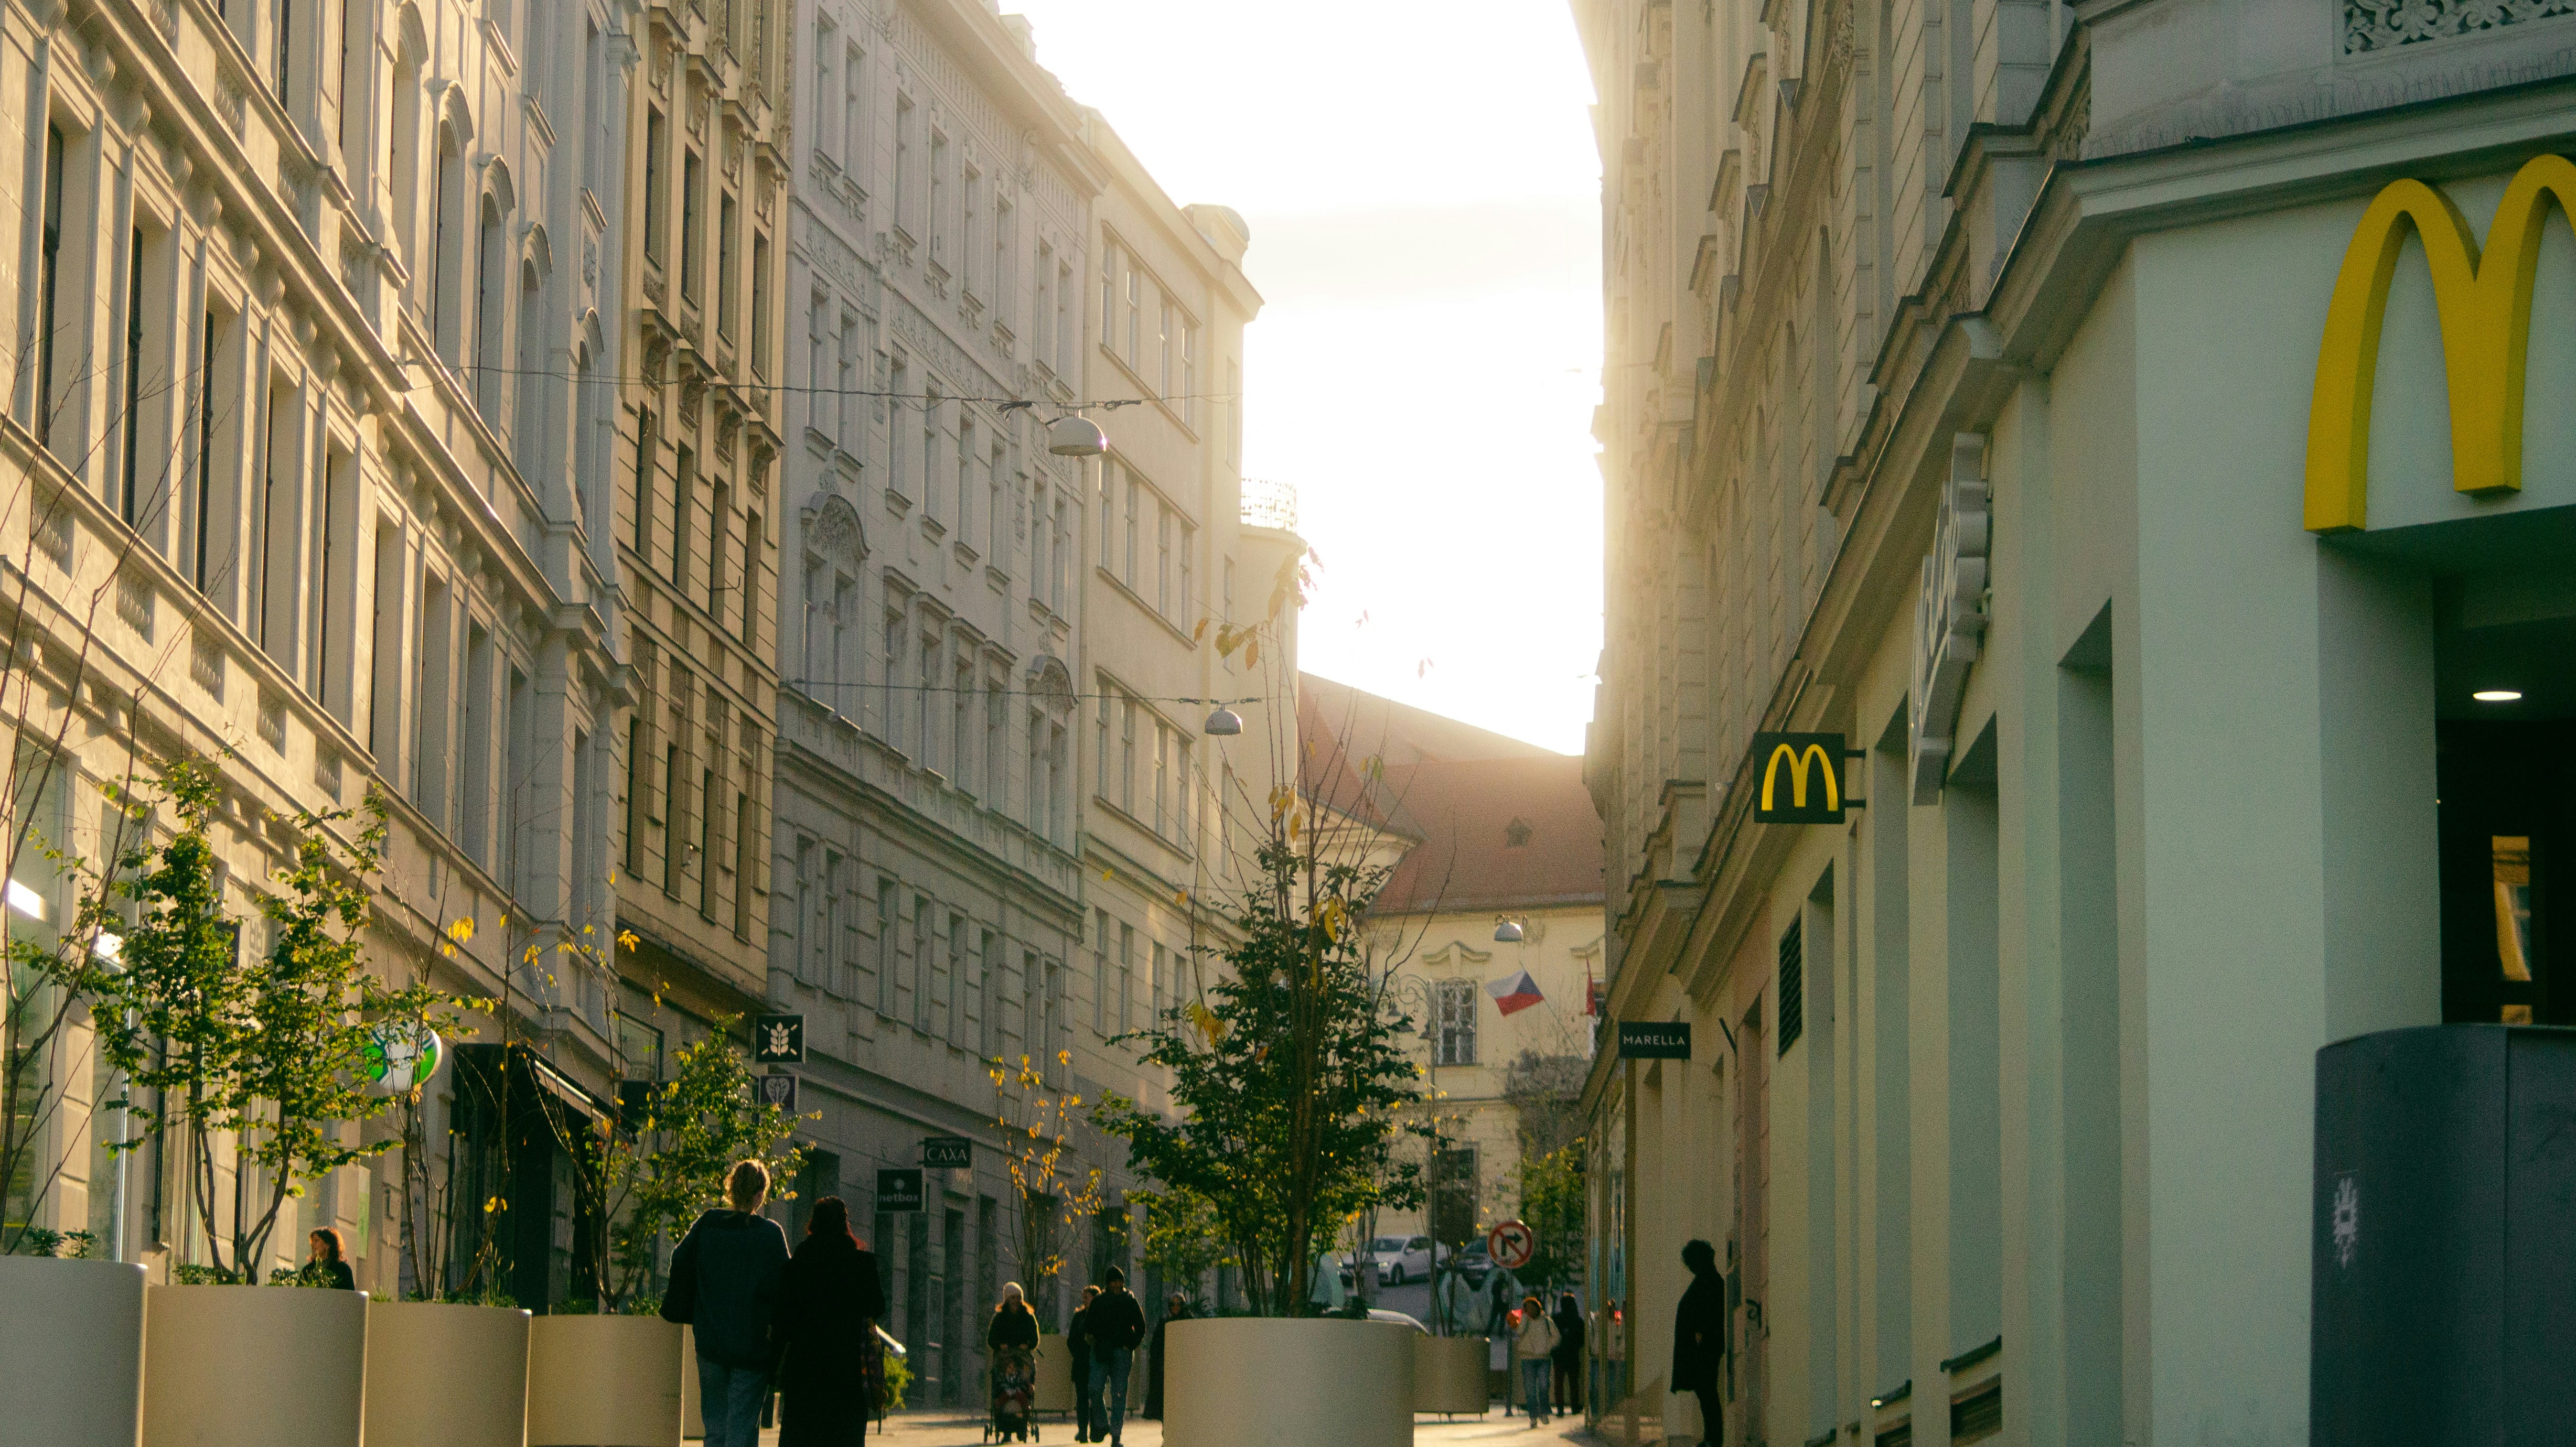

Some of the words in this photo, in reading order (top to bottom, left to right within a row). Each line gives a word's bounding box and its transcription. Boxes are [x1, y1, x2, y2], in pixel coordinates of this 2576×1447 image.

[1623, 1034, 1686, 1046] MARELLA
[927, 1147, 967, 1161] CAXA
[878, 1193, 918, 1203] netbox
